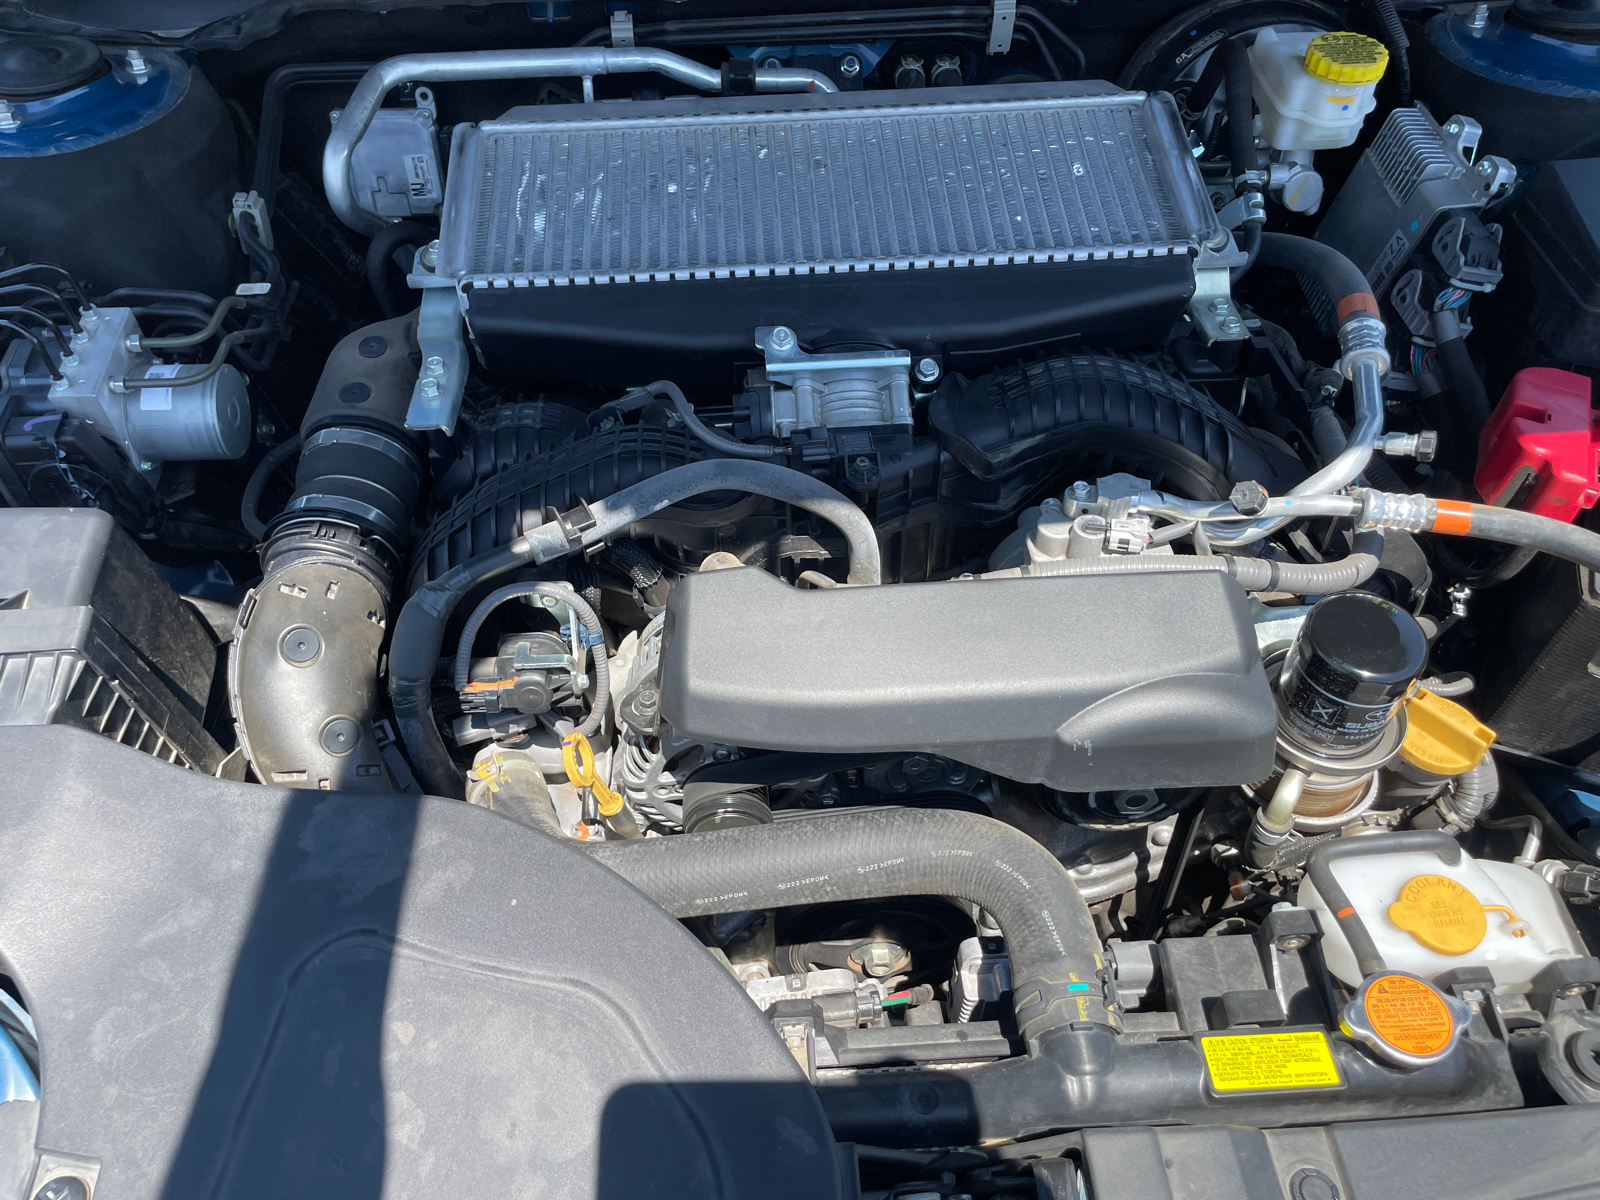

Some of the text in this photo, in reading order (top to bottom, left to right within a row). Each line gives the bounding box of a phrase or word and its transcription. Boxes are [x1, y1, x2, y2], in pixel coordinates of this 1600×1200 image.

[410, 183, 426, 196] MJ
[1317, 724, 1337, 735] PARTS
[1345, 720, 1385, 728] SUBA
[1313, 730, 1333, 741] ONLY
[1405, 877, 1469, 903] COOLANT
[1430, 900, 1449, 909] SEE
[1433, 917, 1468, 928] MANUAL
[1393, 1033, 1442, 1041] AVERTISSEMENT
